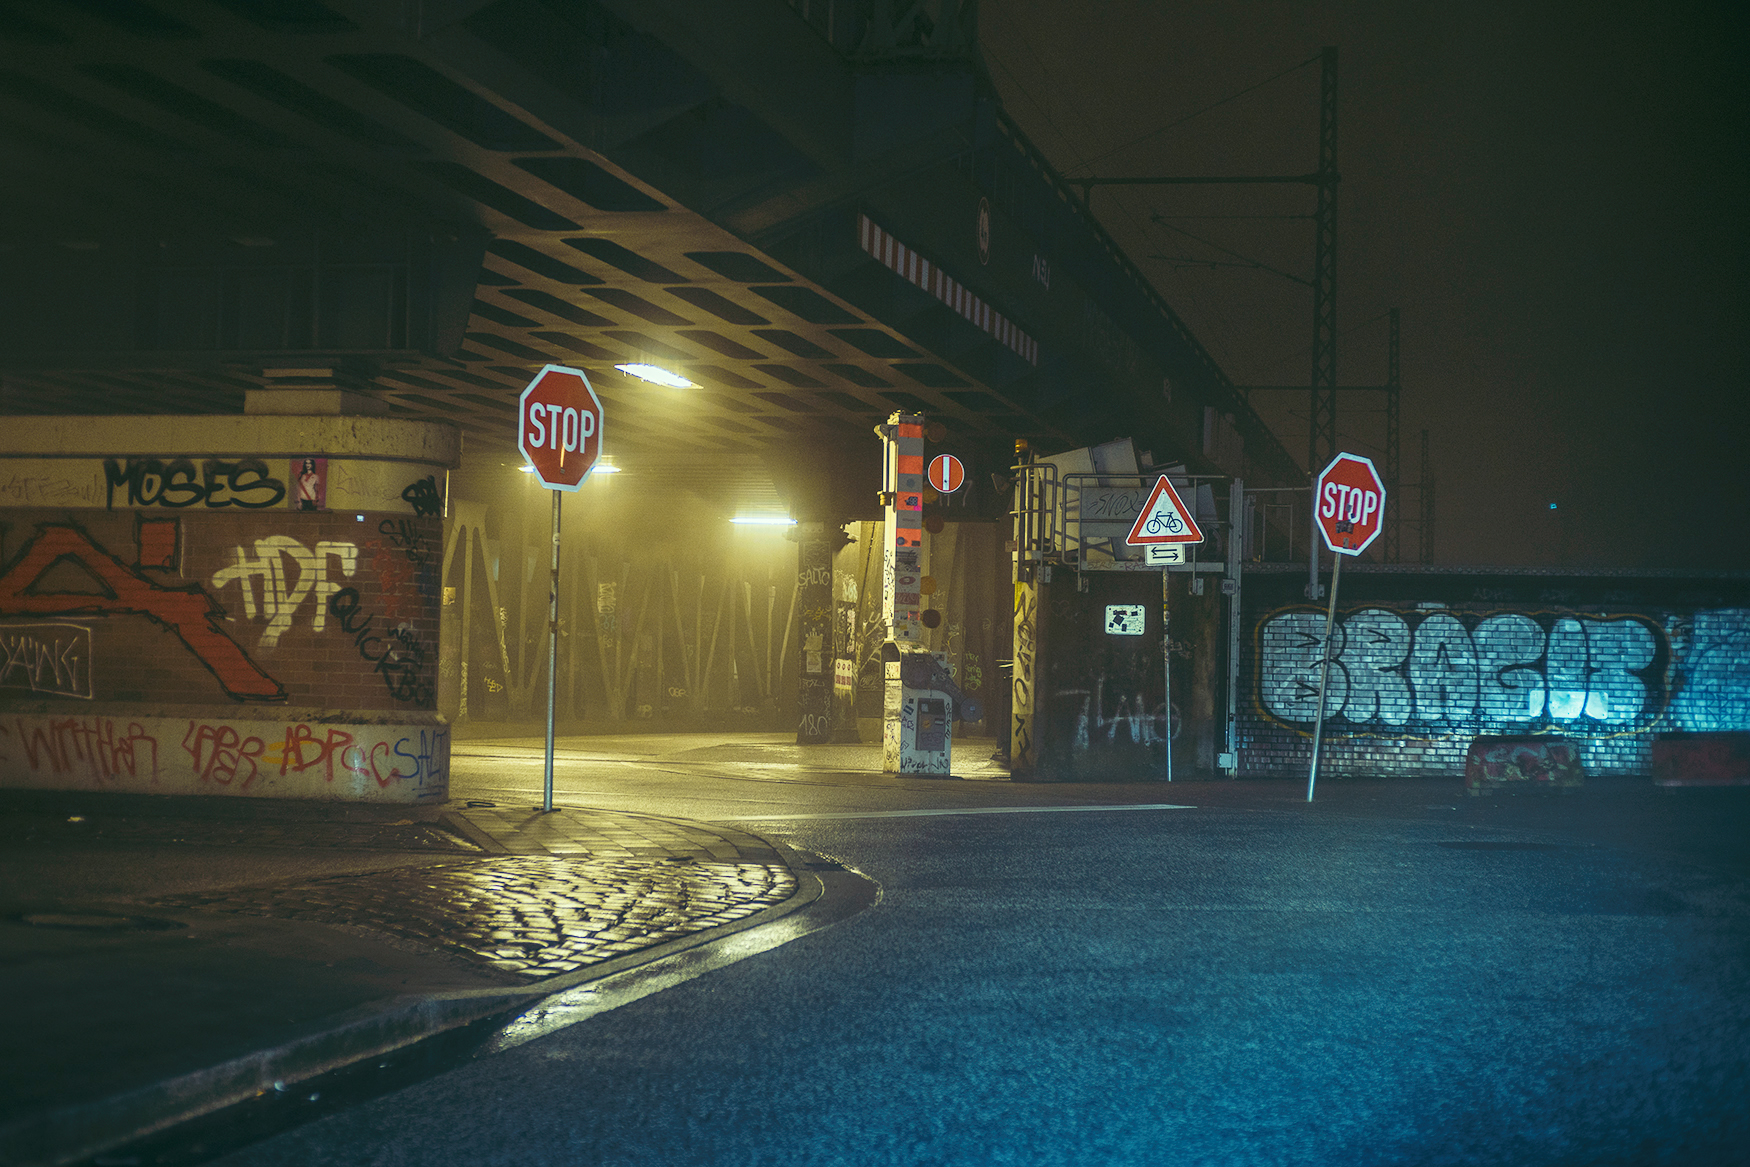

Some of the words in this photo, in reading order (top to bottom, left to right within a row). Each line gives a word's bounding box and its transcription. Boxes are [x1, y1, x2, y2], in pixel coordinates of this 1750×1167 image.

[528, 402, 595, 454] STOP
[103, 458, 286, 511] MOSES
[1322, 482, 1378, 526] STOP
